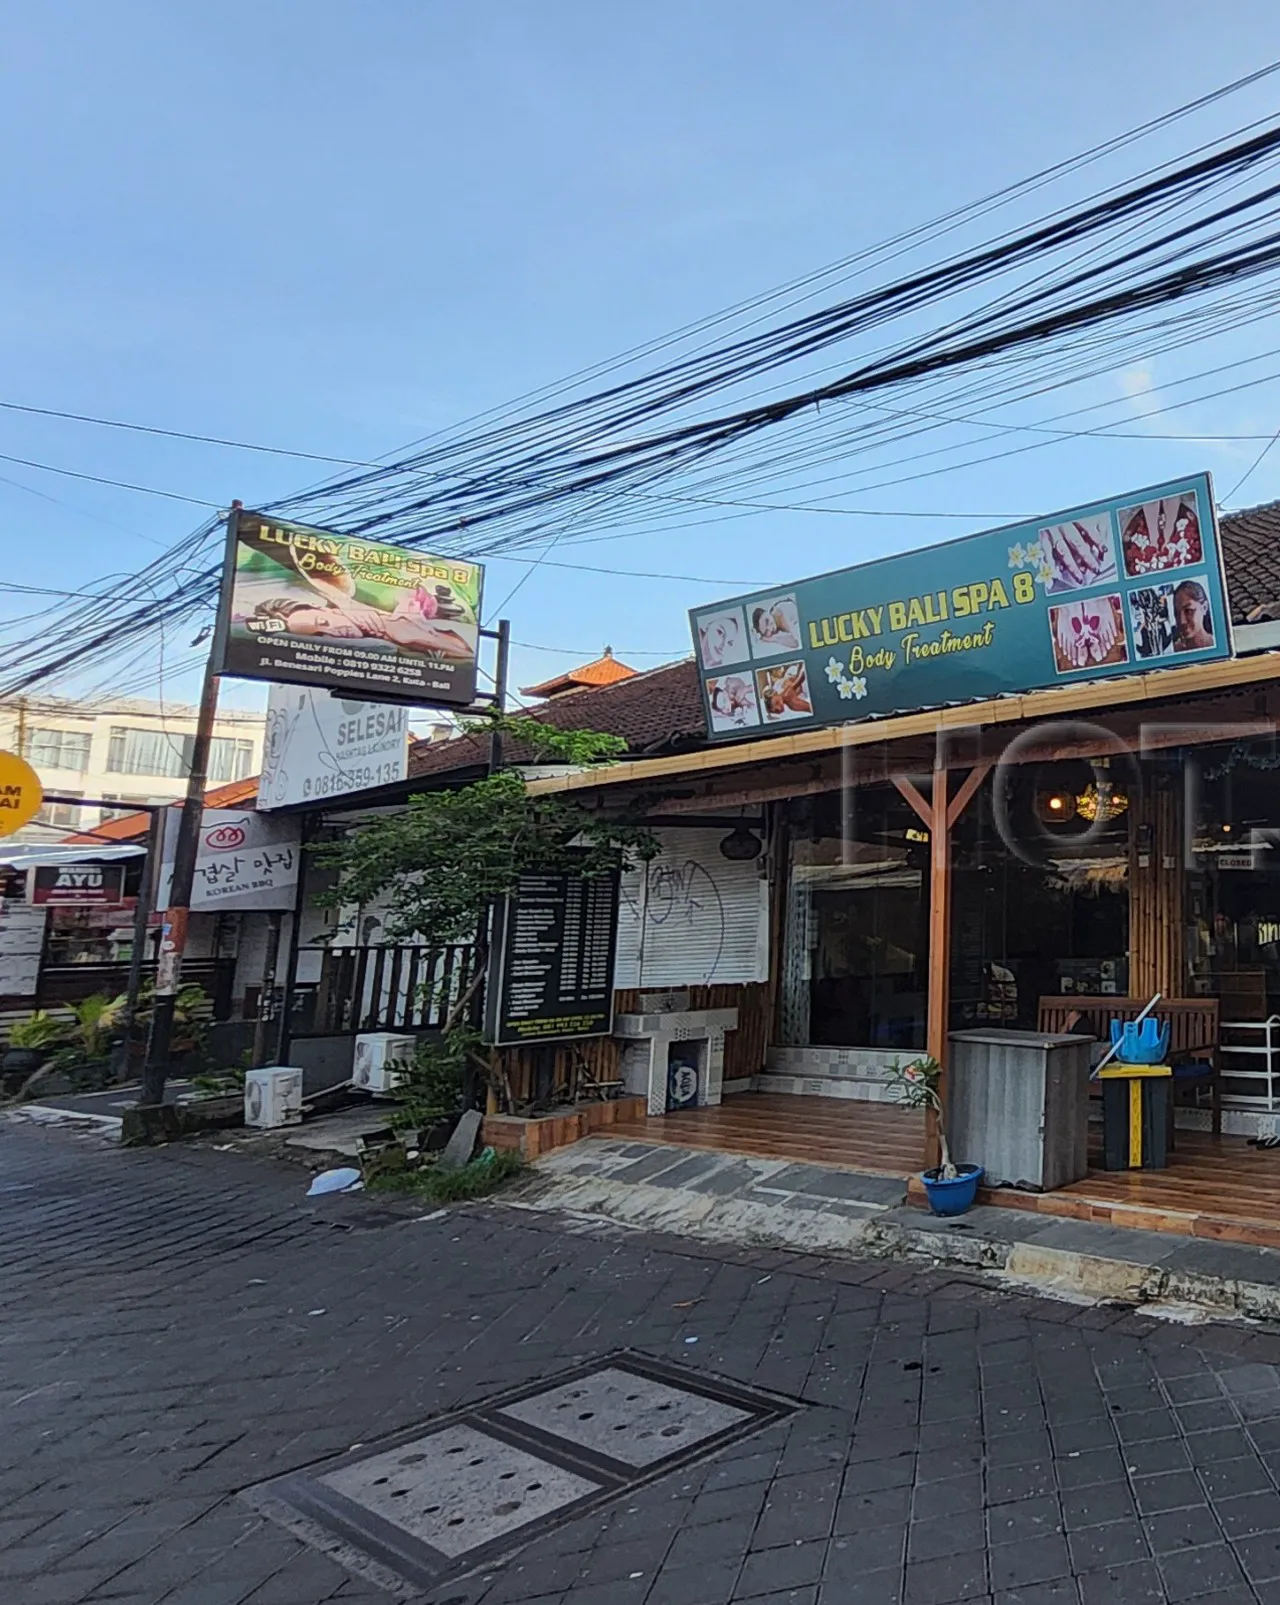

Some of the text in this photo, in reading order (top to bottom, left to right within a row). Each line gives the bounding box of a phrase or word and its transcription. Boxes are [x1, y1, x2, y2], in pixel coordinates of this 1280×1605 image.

[259, 525, 343, 555] LUCKY
[349, 542, 401, 570] BALI
[453, 567, 469, 584] 8
[299, 552, 422, 589] Body Treatment
[808, 571, 1035, 648] LUCKY BALI SPA 8
[257, 636, 289, 648] OPEN
[290, 641, 321, 654] DAILY
[322, 645, 352, 658] FROM
[380, 654, 397, 663] AM
[398, 657, 426, 668] UNTIL
[296, 652, 336, 665] Mobile
[342, 659, 369, 670] 0819
[849, 621, 996, 675] Body Treatment
[274, 659, 322, 673] Benesari
[324, 665, 365, 680] Poppies
[366, 672, 391, 682] Lane
[403, 677, 425, 687] Kuta
[337, 706, 402, 746] SELESAI
[1219, 858, 1253, 867] CLOSED
[55, 874, 103, 887] AYU
[206, 879, 274, 897] KOREAN BBQ
